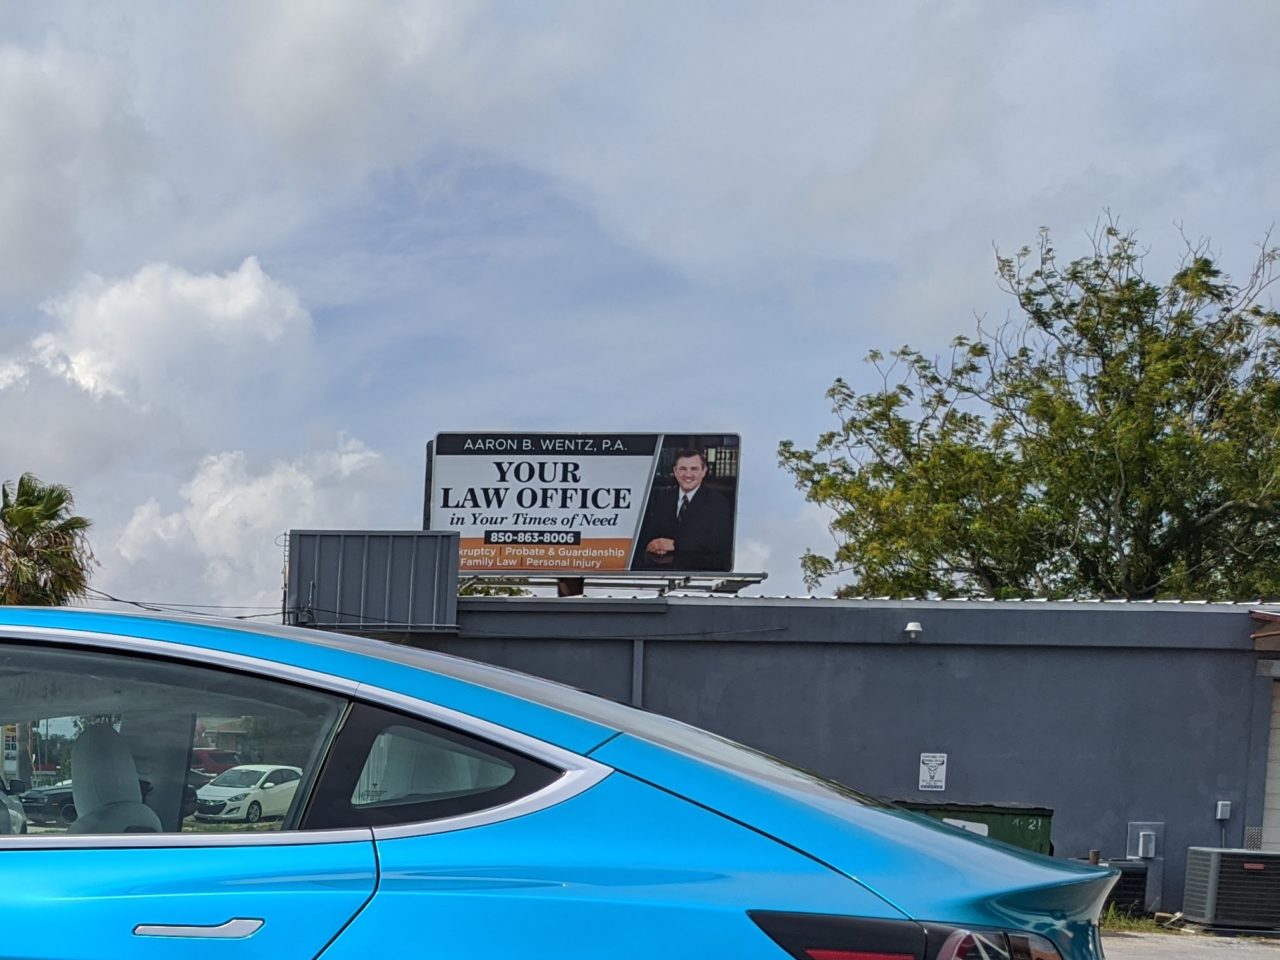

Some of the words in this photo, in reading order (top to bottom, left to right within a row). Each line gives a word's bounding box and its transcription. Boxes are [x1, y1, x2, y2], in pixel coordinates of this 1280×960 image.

[463, 439, 517, 450] AARON
[522, 440, 535, 450] B.
[540, 440, 597, 451] WENTZ,
[602, 440, 628, 451] P.A.
[492, 461, 581, 483] YOUR
[439, 487, 510, 509] LAW
[516, 487, 632, 510] OFFICE
[449, 513, 465, 526] in
[470, 513, 508, 526] Your
[512, 513, 558, 526] Times
[560, 514, 579, 529] of
[579, 514, 619, 527] Need
[490, 532, 575, 544] 850-863-8006
[505, 547, 545, 556] Probate
[548, 548, 555, 556] &
[558, 547, 625, 558] Guardianship
[460, 557, 493, 567] Family
[496, 558, 517, 567] Law
[526, 558, 570, 568] Personal
[573, 558, 602, 569] Injury
